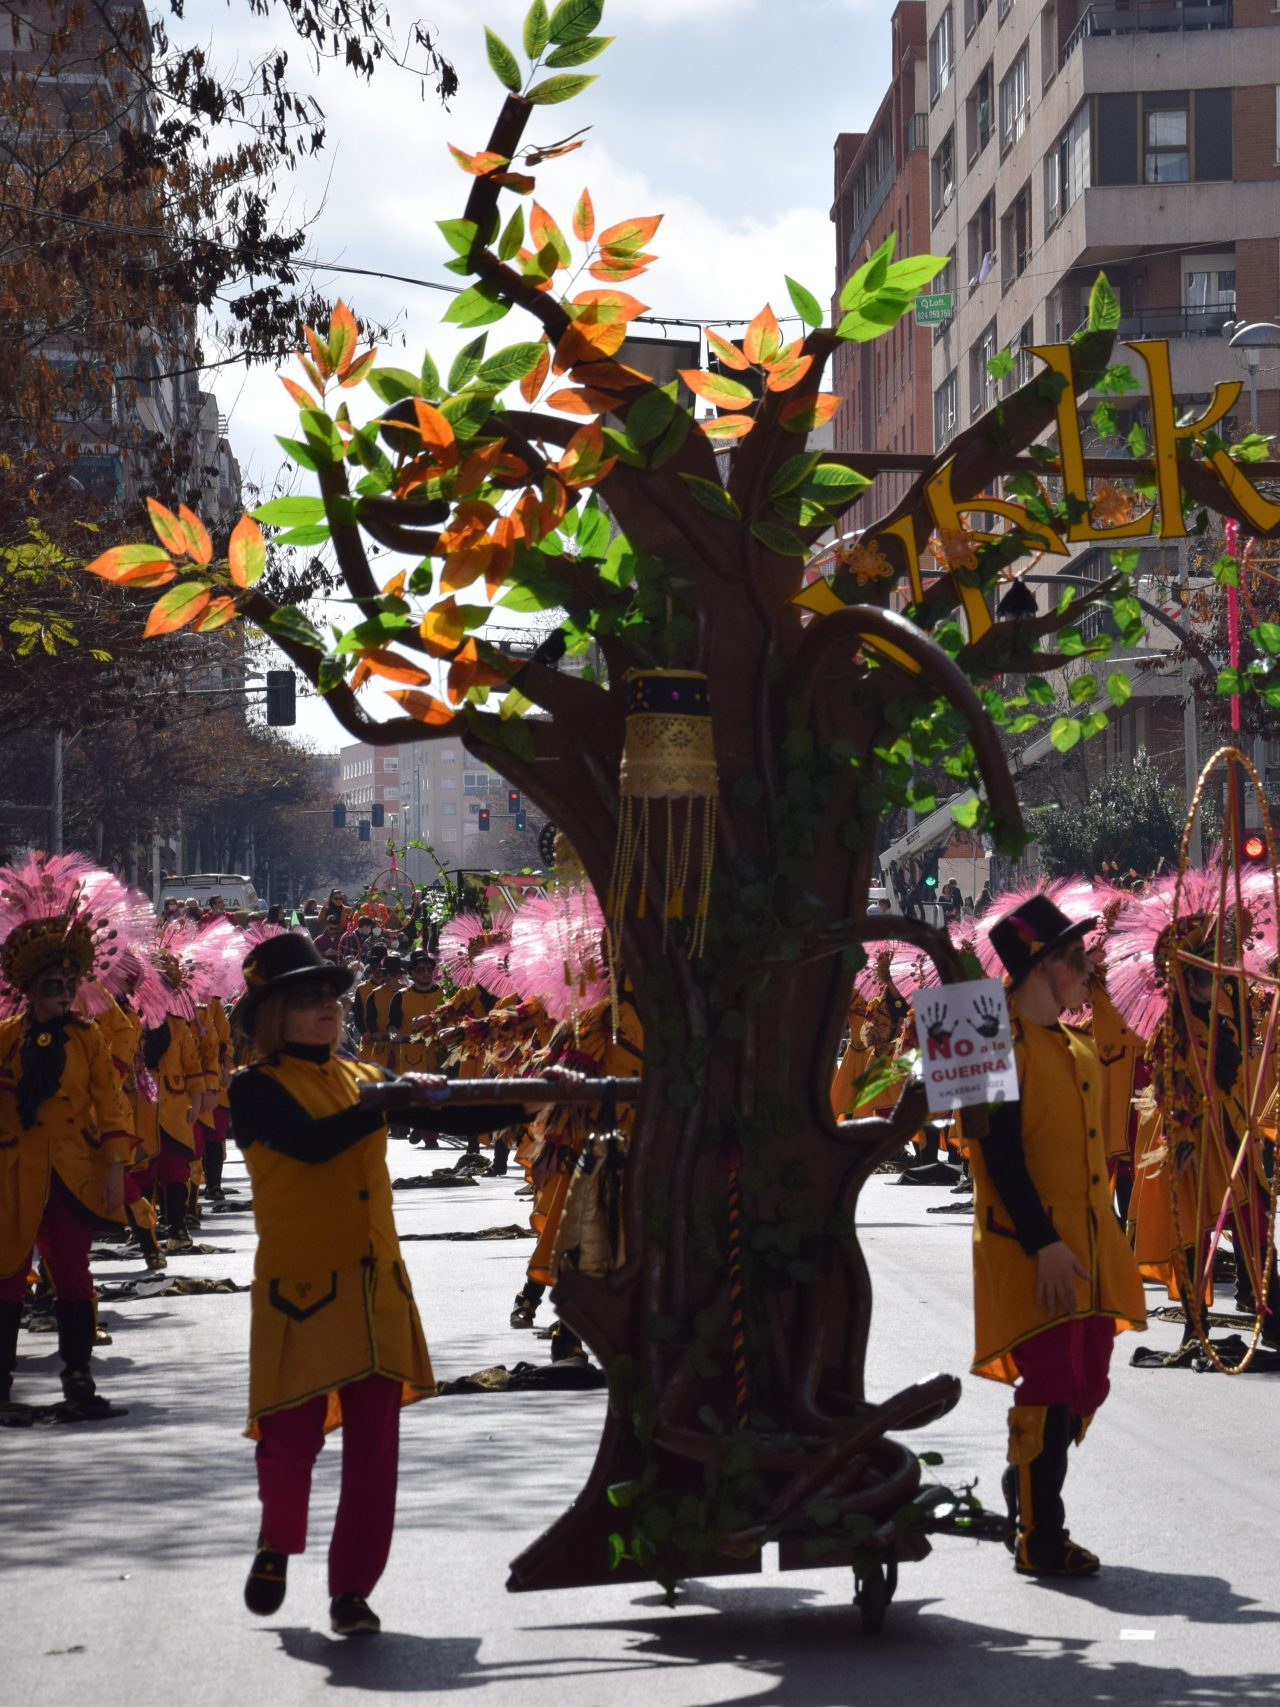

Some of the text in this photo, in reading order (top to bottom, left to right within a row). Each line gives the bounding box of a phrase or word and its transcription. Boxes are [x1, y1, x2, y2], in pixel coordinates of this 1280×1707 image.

[981, 1044, 988, 1053] a
[993, 1041, 1005, 1051] la
[931, 1059, 1007, 1082] GUERRA
